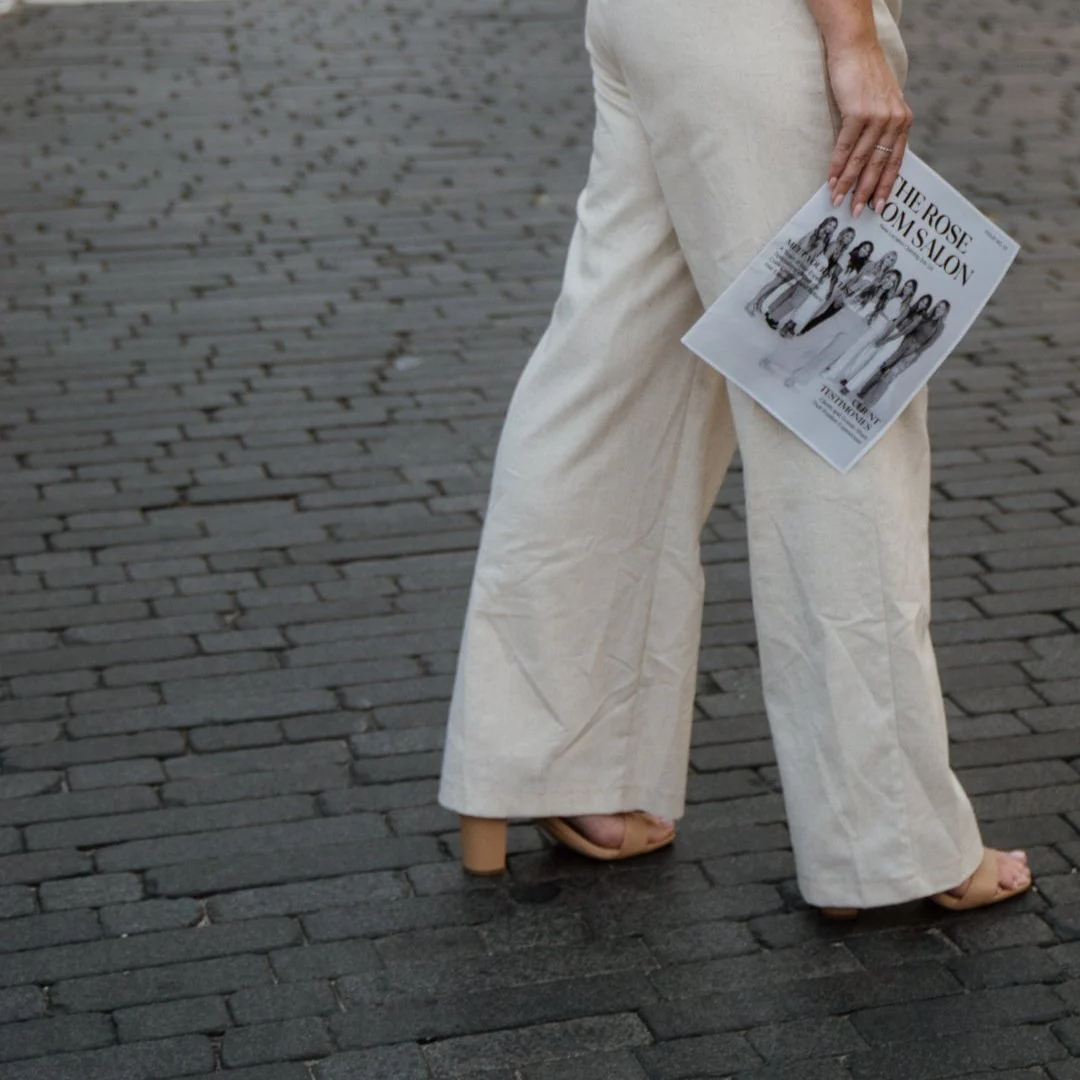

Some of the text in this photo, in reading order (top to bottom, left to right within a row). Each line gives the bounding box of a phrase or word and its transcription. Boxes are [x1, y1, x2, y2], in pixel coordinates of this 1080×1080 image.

[921, 203, 973, 254] ROSE
[911, 228, 974, 286] SALON
[820, 384, 871, 431] TESTIMONIES
[851, 399, 880, 425] CLIENT
